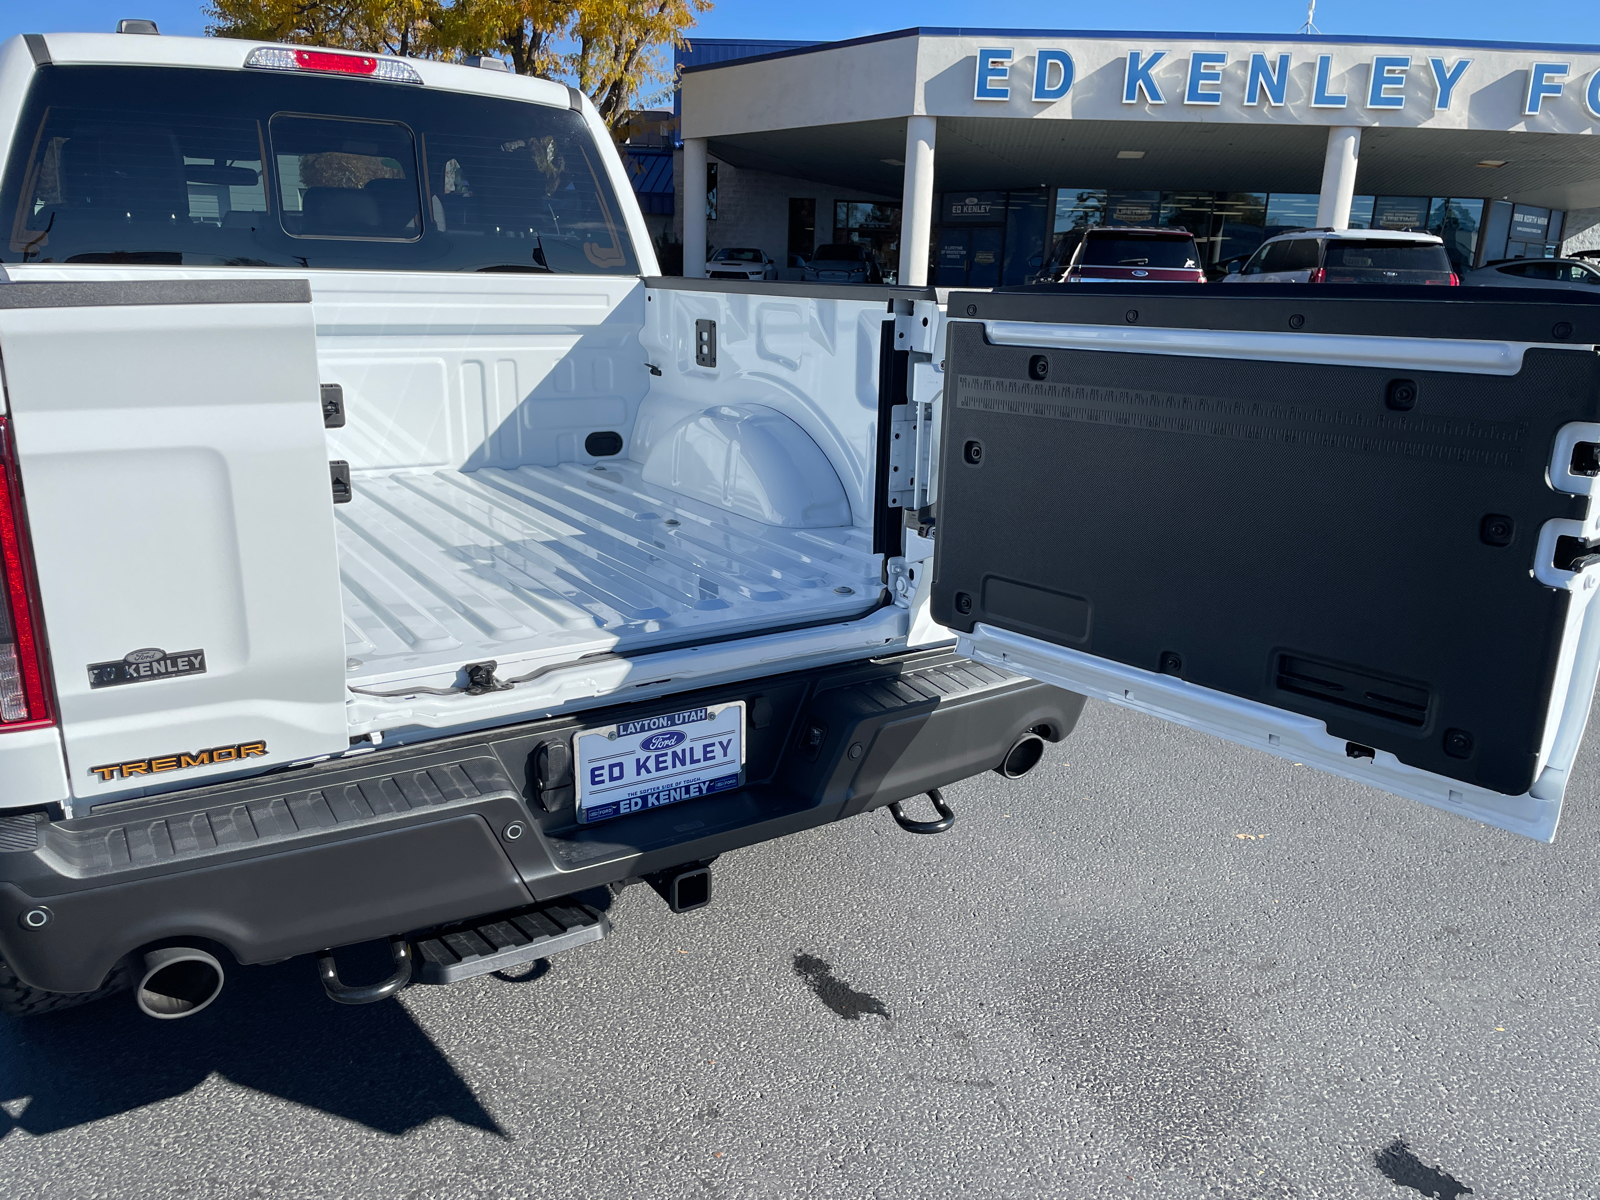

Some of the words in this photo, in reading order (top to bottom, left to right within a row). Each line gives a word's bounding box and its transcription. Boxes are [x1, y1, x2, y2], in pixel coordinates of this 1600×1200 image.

[973, 47, 1076, 103] ED
[1121, 49, 1474, 112] KENLEY
[125, 655, 202, 679] KENLEY
[134, 652, 156, 662] Ford
[619, 714, 671, 736] LAYTON,
[674, 708, 706, 724] UTAH
[650, 734, 677, 750] Ford
[92, 740, 268, 781] TREMOR
[590, 761, 625, 786] ED
[635, 738, 733, 777] KENLEY
[620, 797, 643, 814] ED
[647, 781, 710, 808] KENLEY
[627, 790, 638, 798] THE
[639, 786, 660, 795] SOFTER
[661, 782, 674, 791] SIDE
